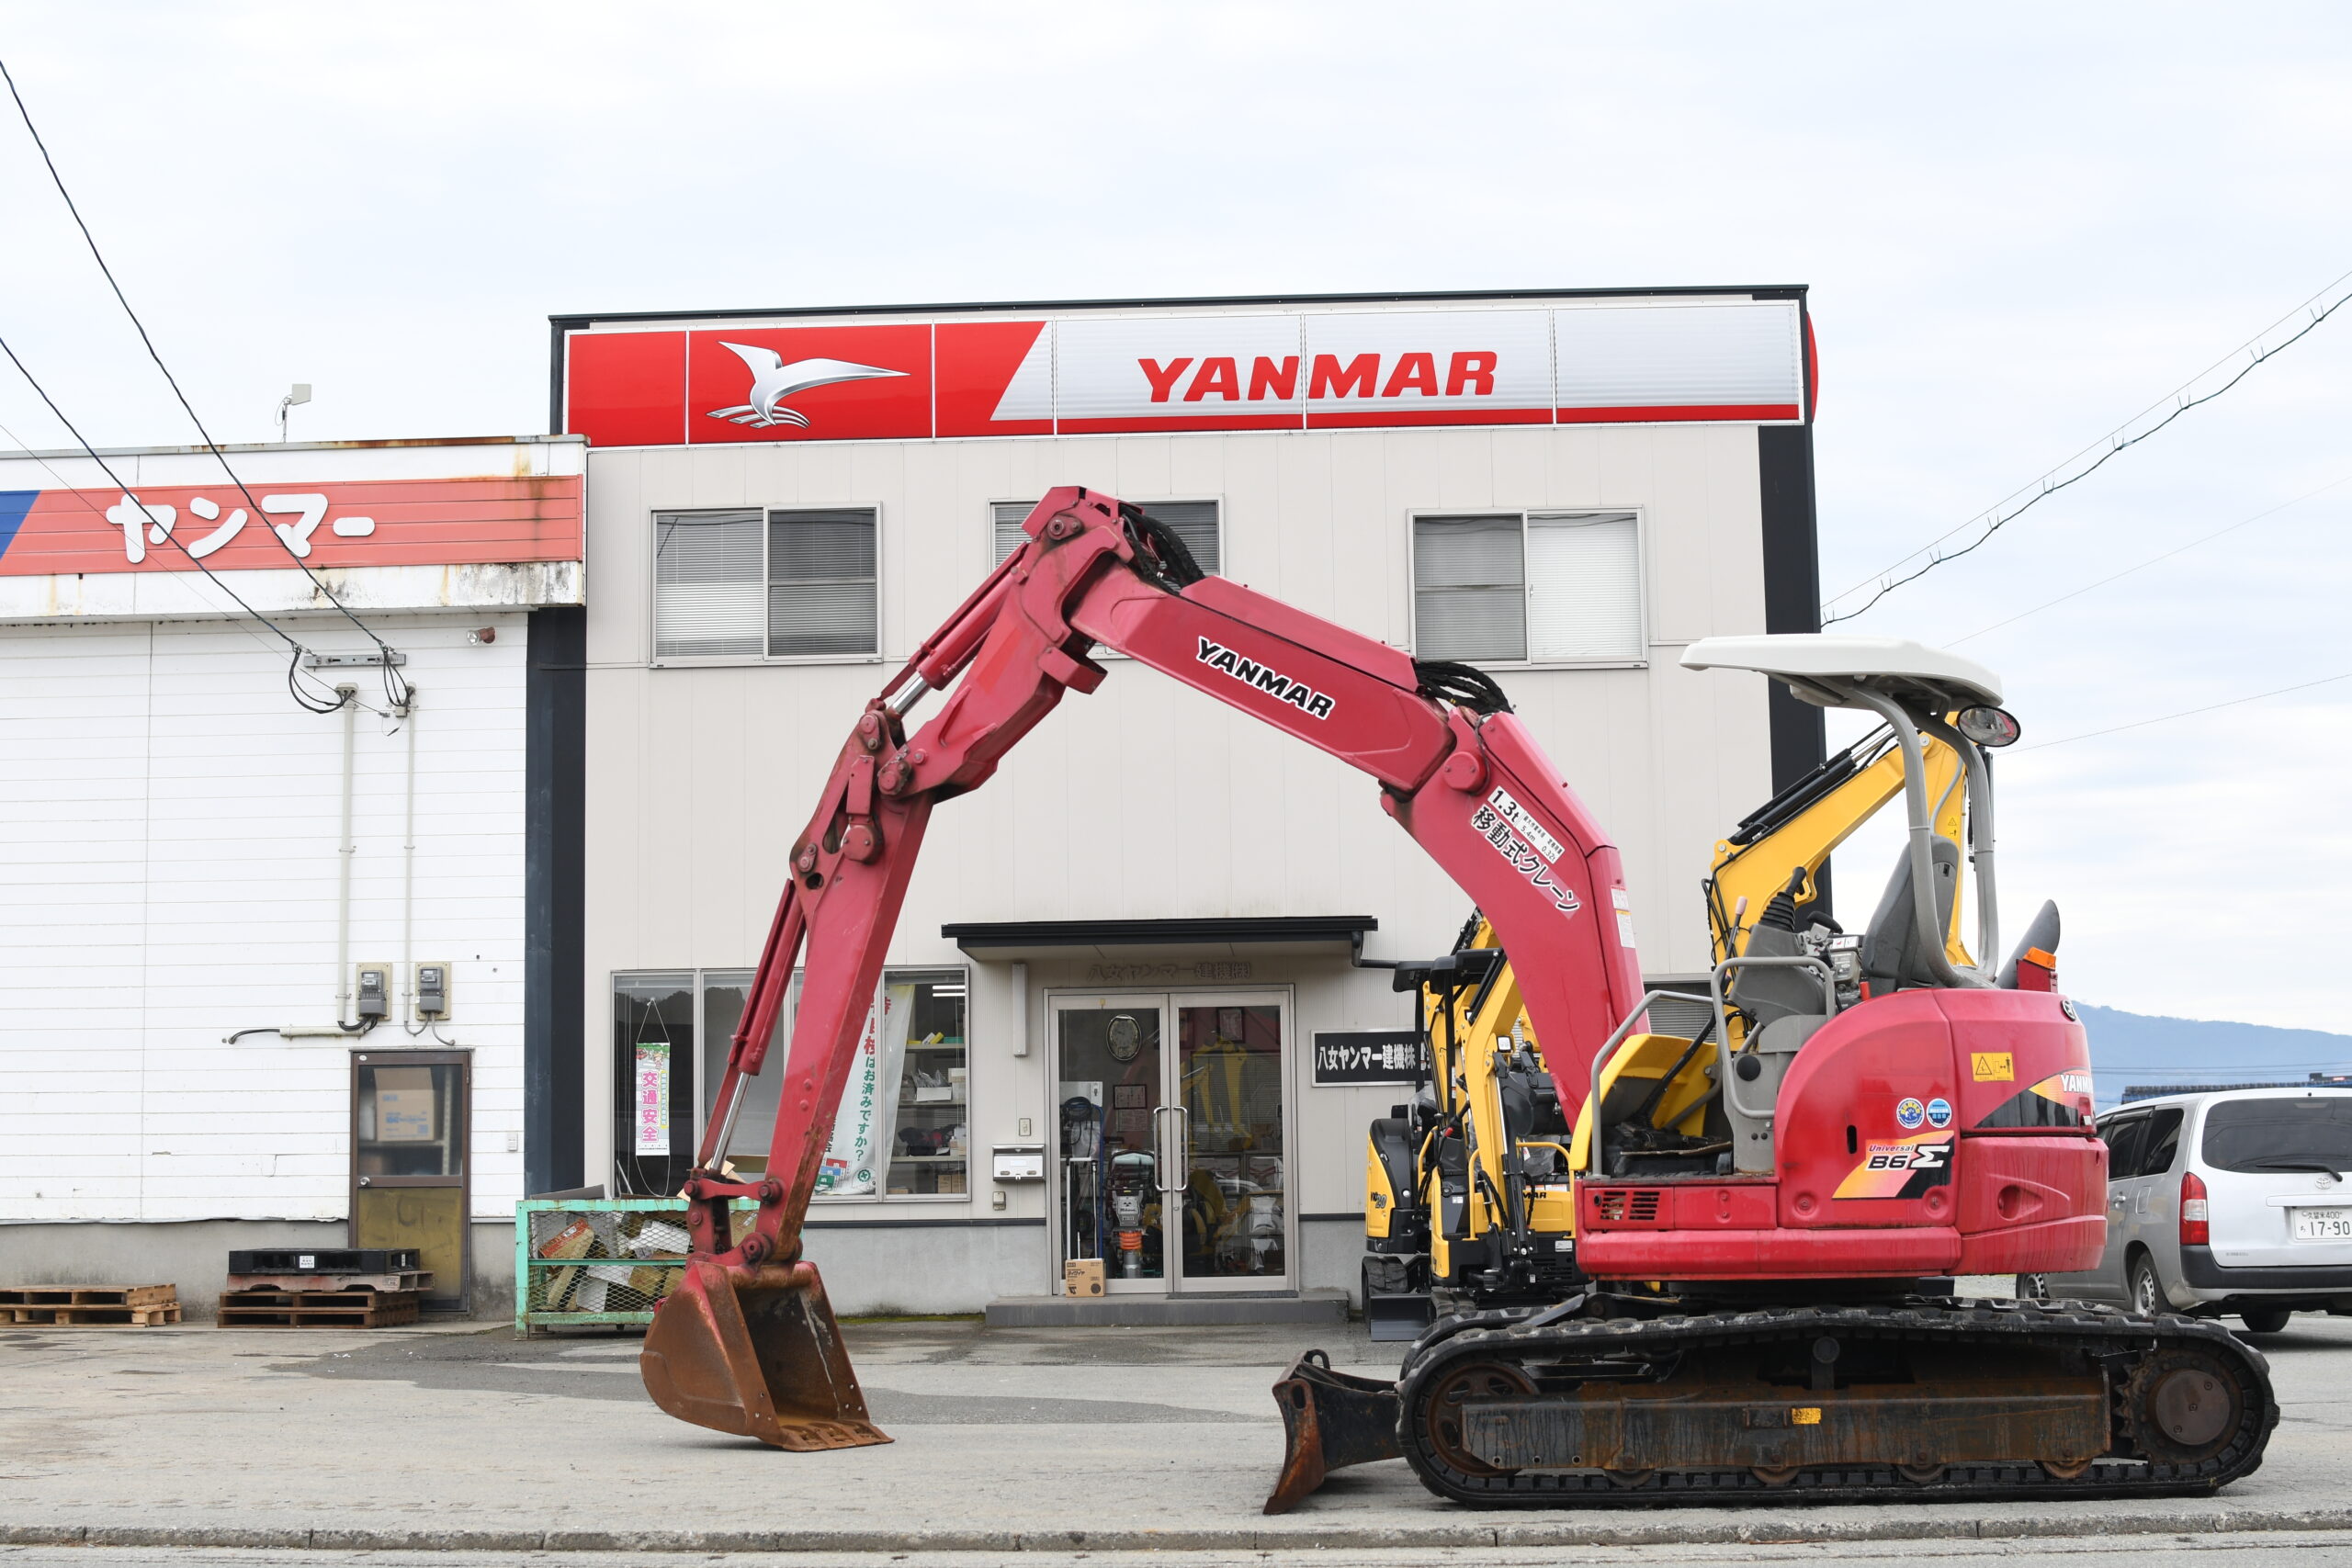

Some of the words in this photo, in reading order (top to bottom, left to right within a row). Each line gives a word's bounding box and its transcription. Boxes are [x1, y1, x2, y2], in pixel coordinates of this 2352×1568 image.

[1137, 351, 1498, 403] YANMAR
[106, 493, 376, 564] ヤンマー
[1197, 637, 1334, 719] YANMAR
[1492, 790, 1521, 823] 1.3t
[1472, 806, 1579, 910] 移動式クレーン
[1521, 826, 1536, 842] 5.4m
[1317, 1043, 1430, 1071] 八女ヤンマー建機株
[642, 1071, 659, 1143] 交通安全
[2310, 1221, 2350, 1235] 17-90
